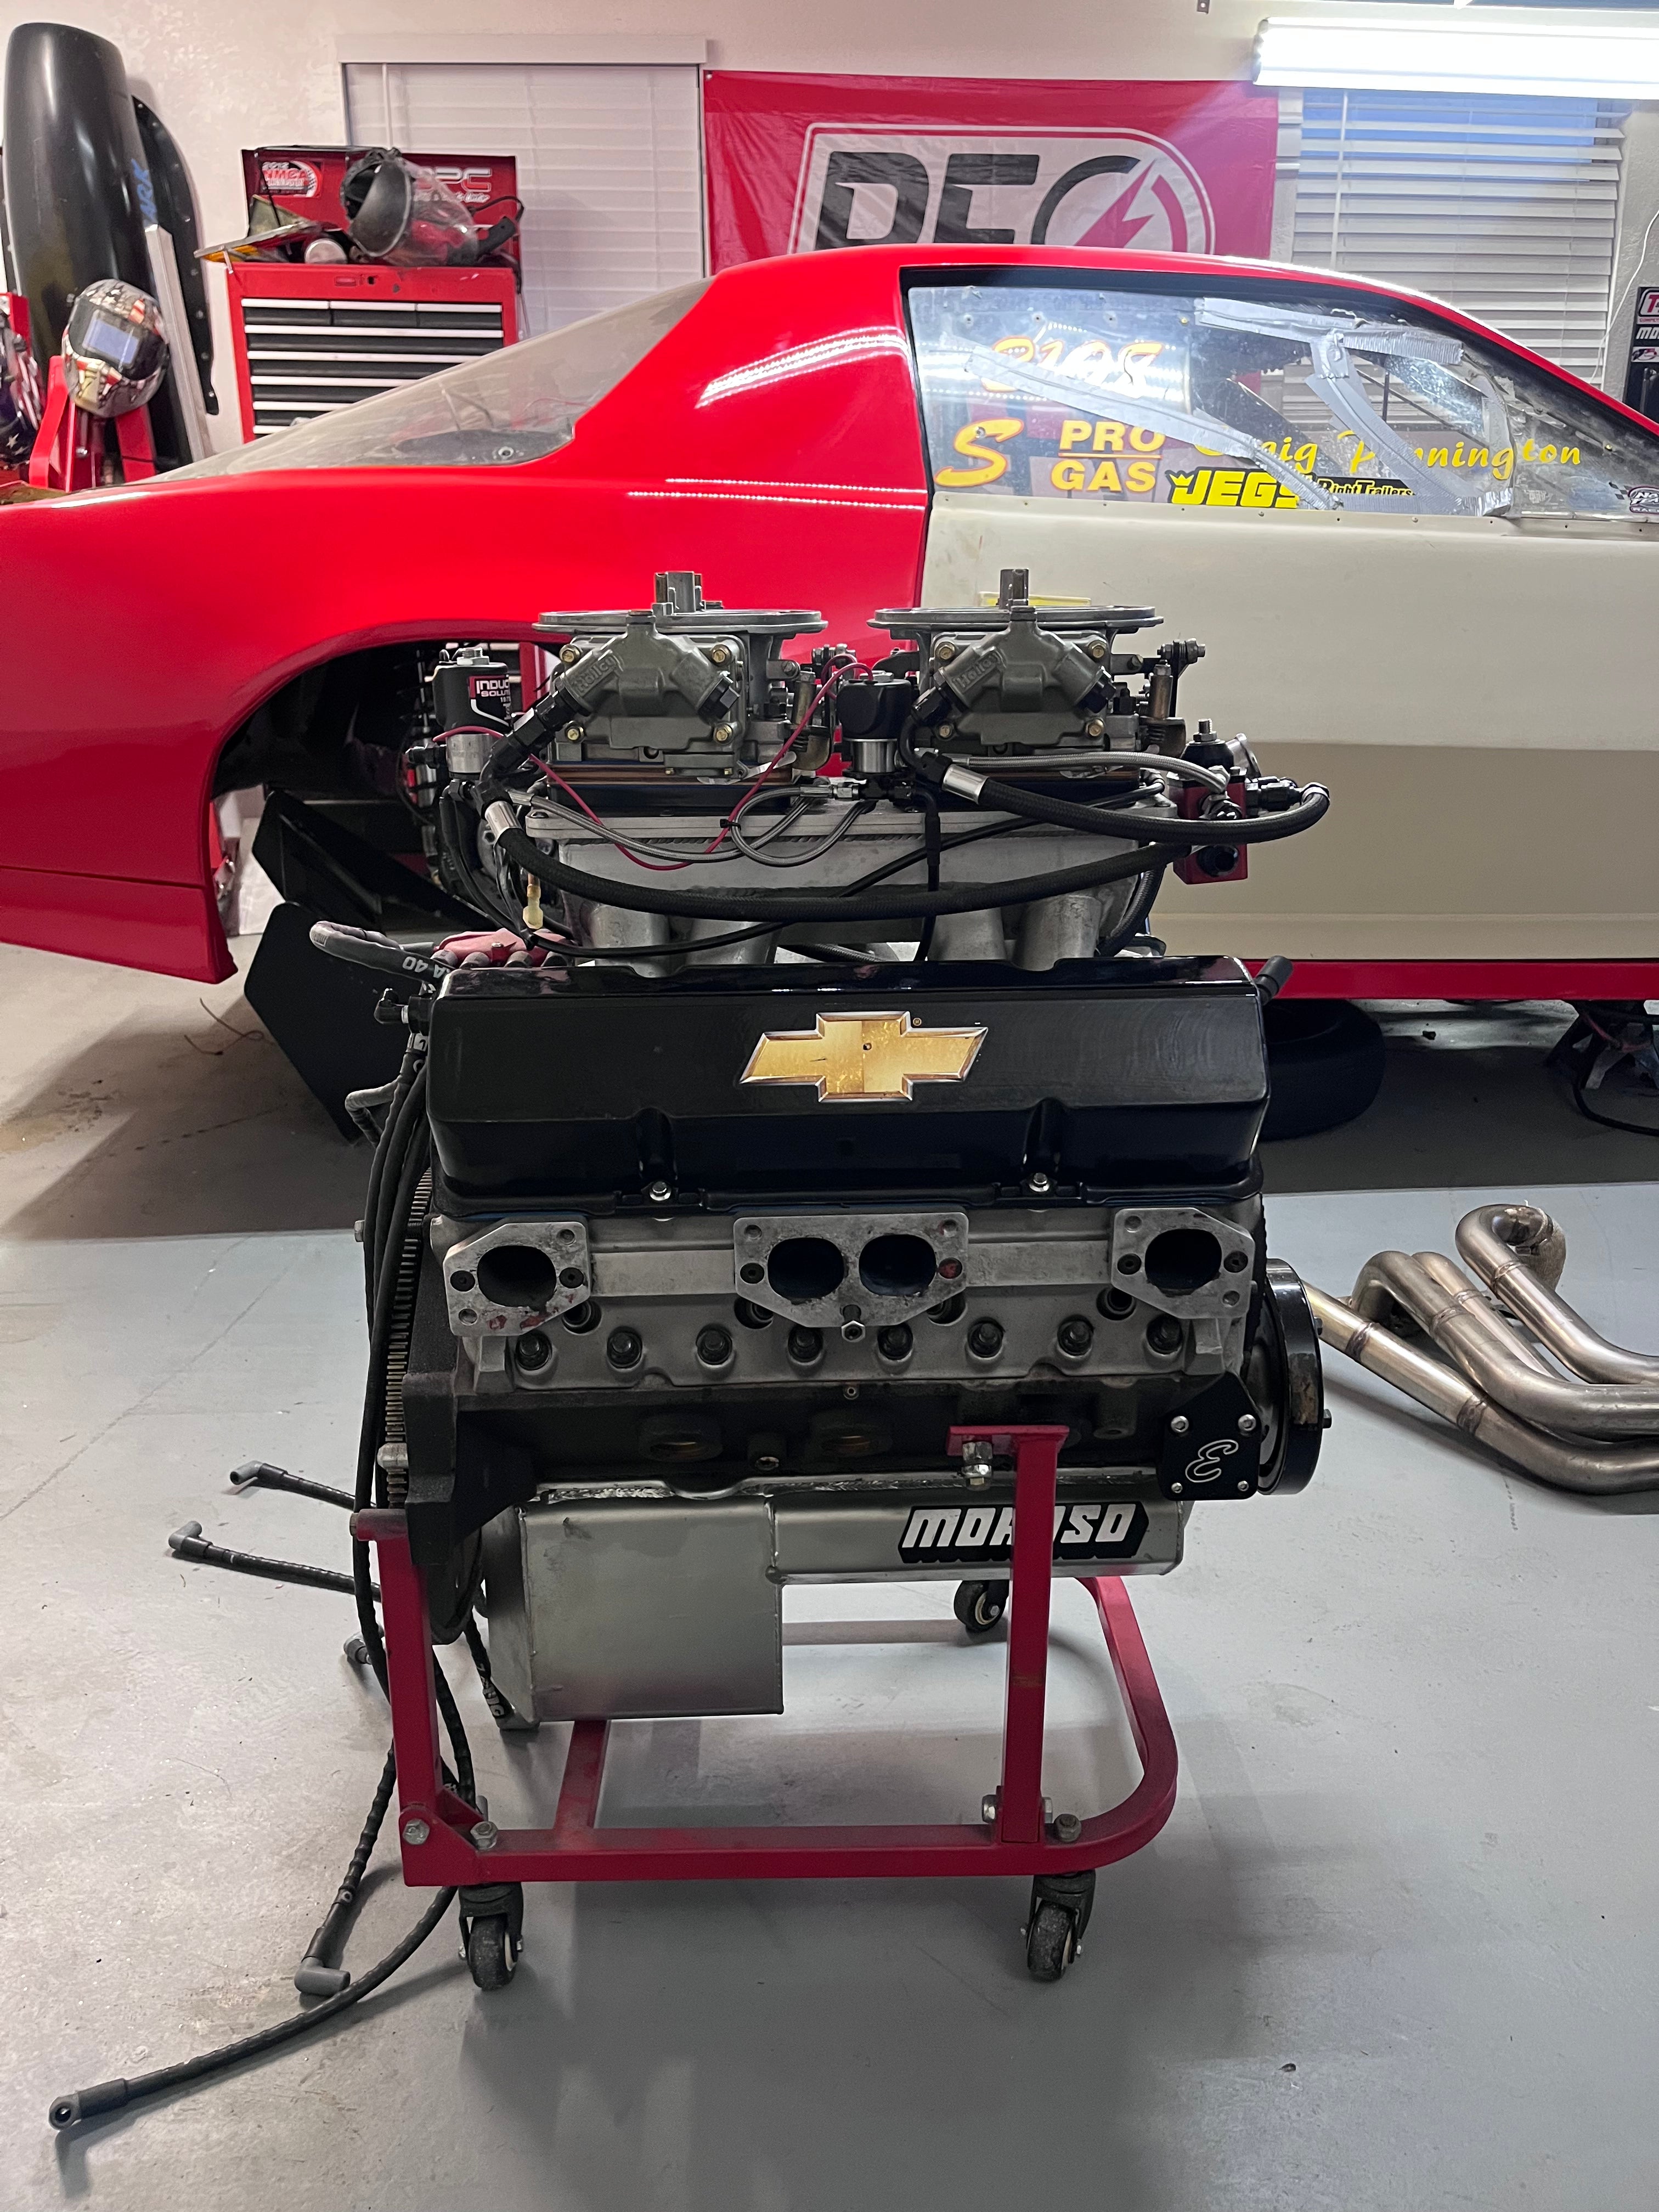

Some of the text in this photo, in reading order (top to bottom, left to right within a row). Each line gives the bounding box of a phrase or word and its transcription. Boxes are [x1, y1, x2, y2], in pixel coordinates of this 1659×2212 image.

[1058, 419, 1166, 452] PRO
[933, 417, 1024, 488] S
[1050, 460, 1156, 492] GAS
